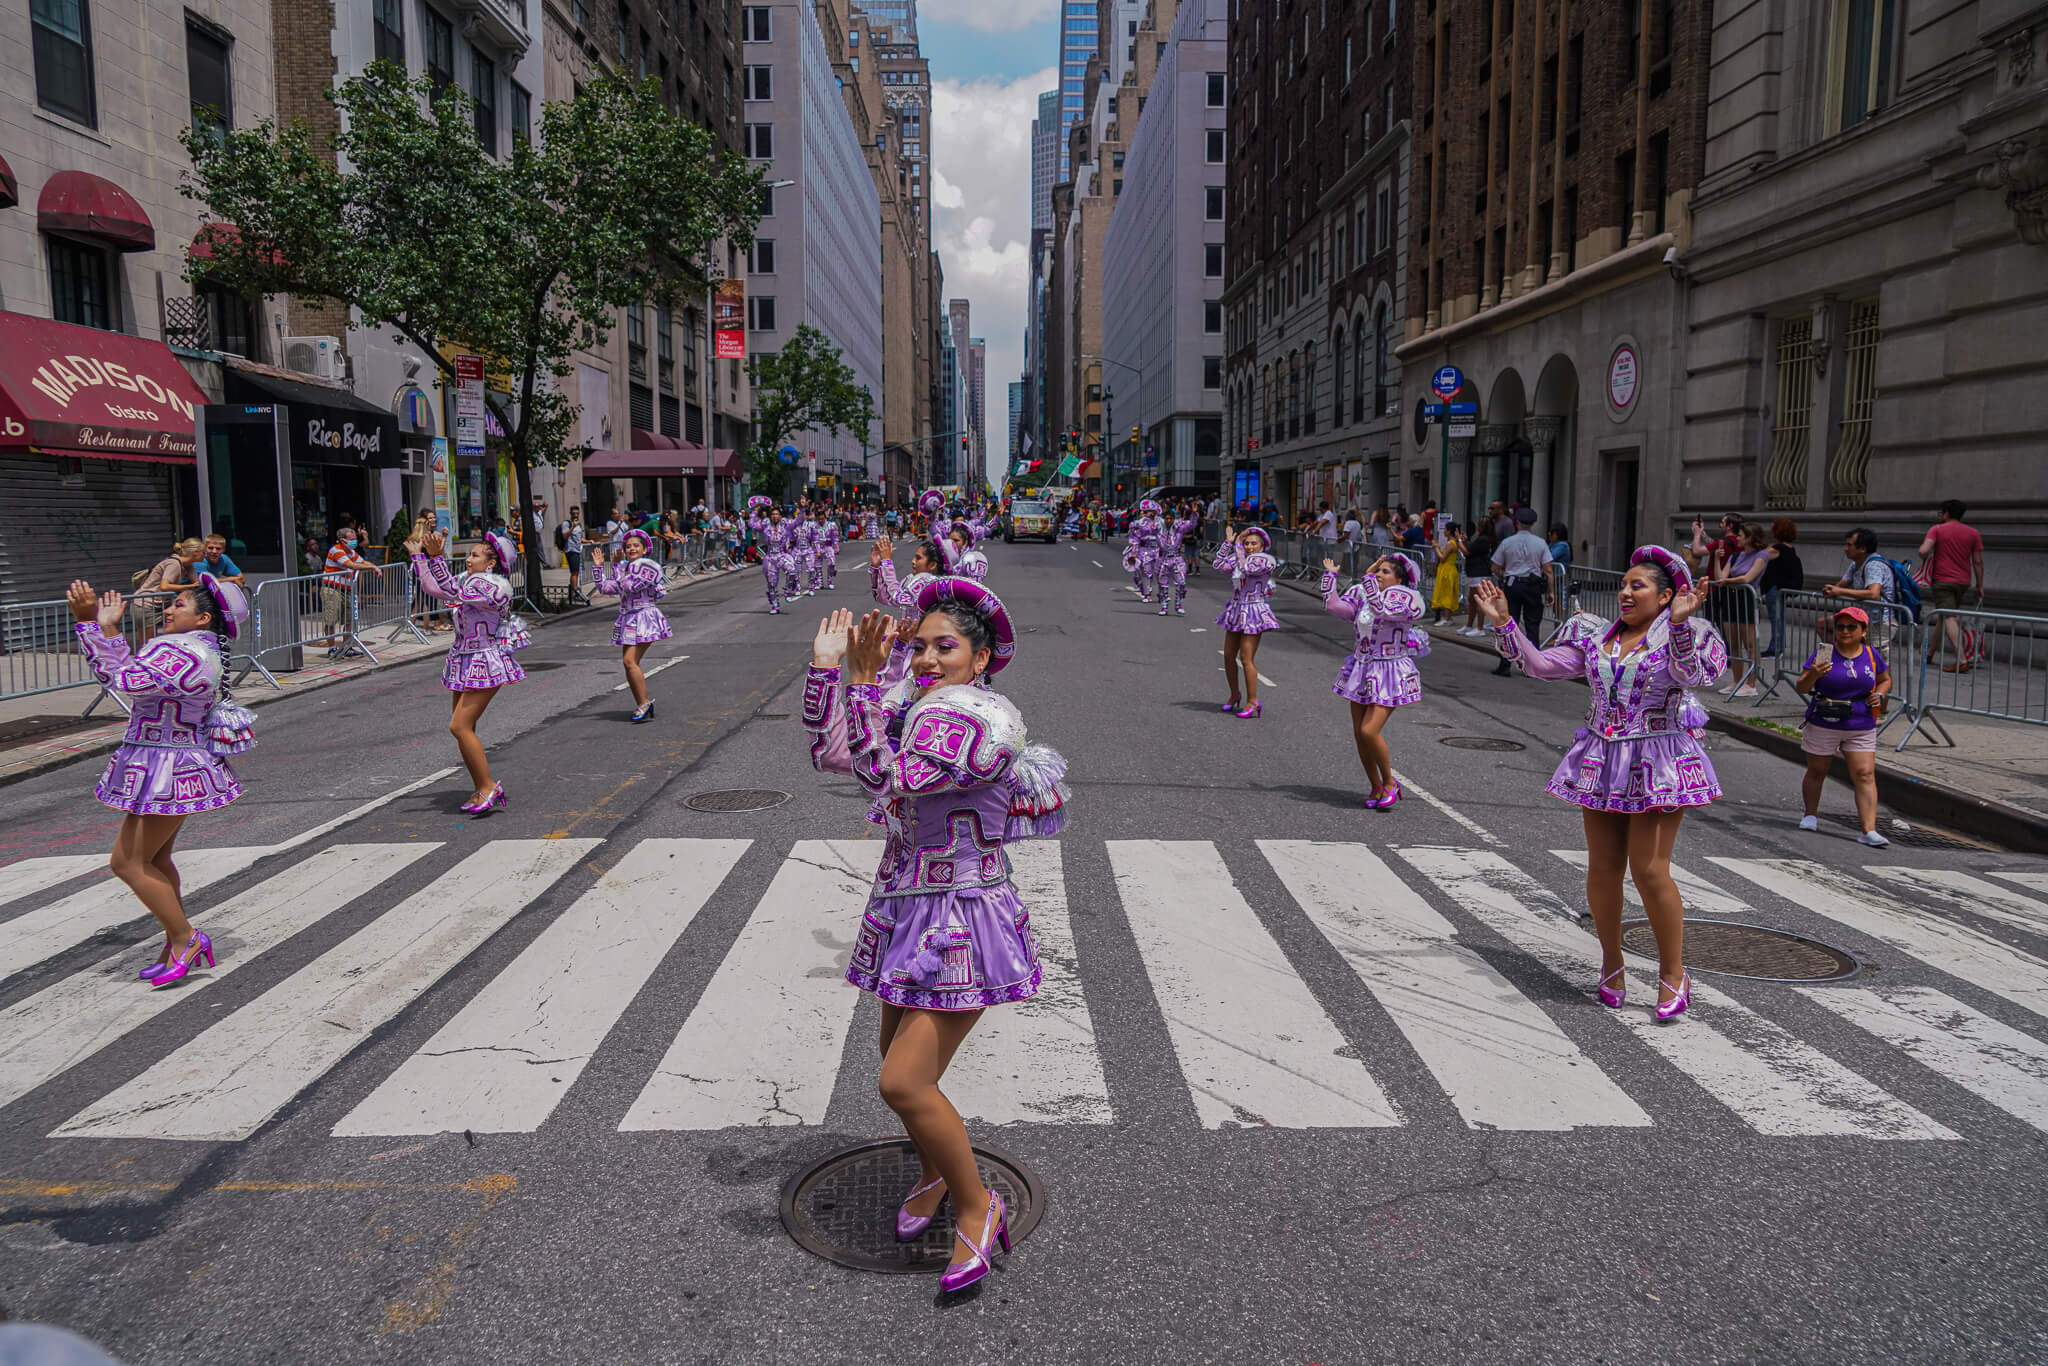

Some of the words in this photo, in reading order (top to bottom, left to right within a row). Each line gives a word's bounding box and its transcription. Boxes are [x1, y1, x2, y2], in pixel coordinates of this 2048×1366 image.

[31, 355, 195, 422] MADISON
[104, 403, 160, 422] bistro
[78, 427, 152, 449] Restaurant
[308, 418, 342, 448] Rico
[343, 422, 381, 461] Bagel
